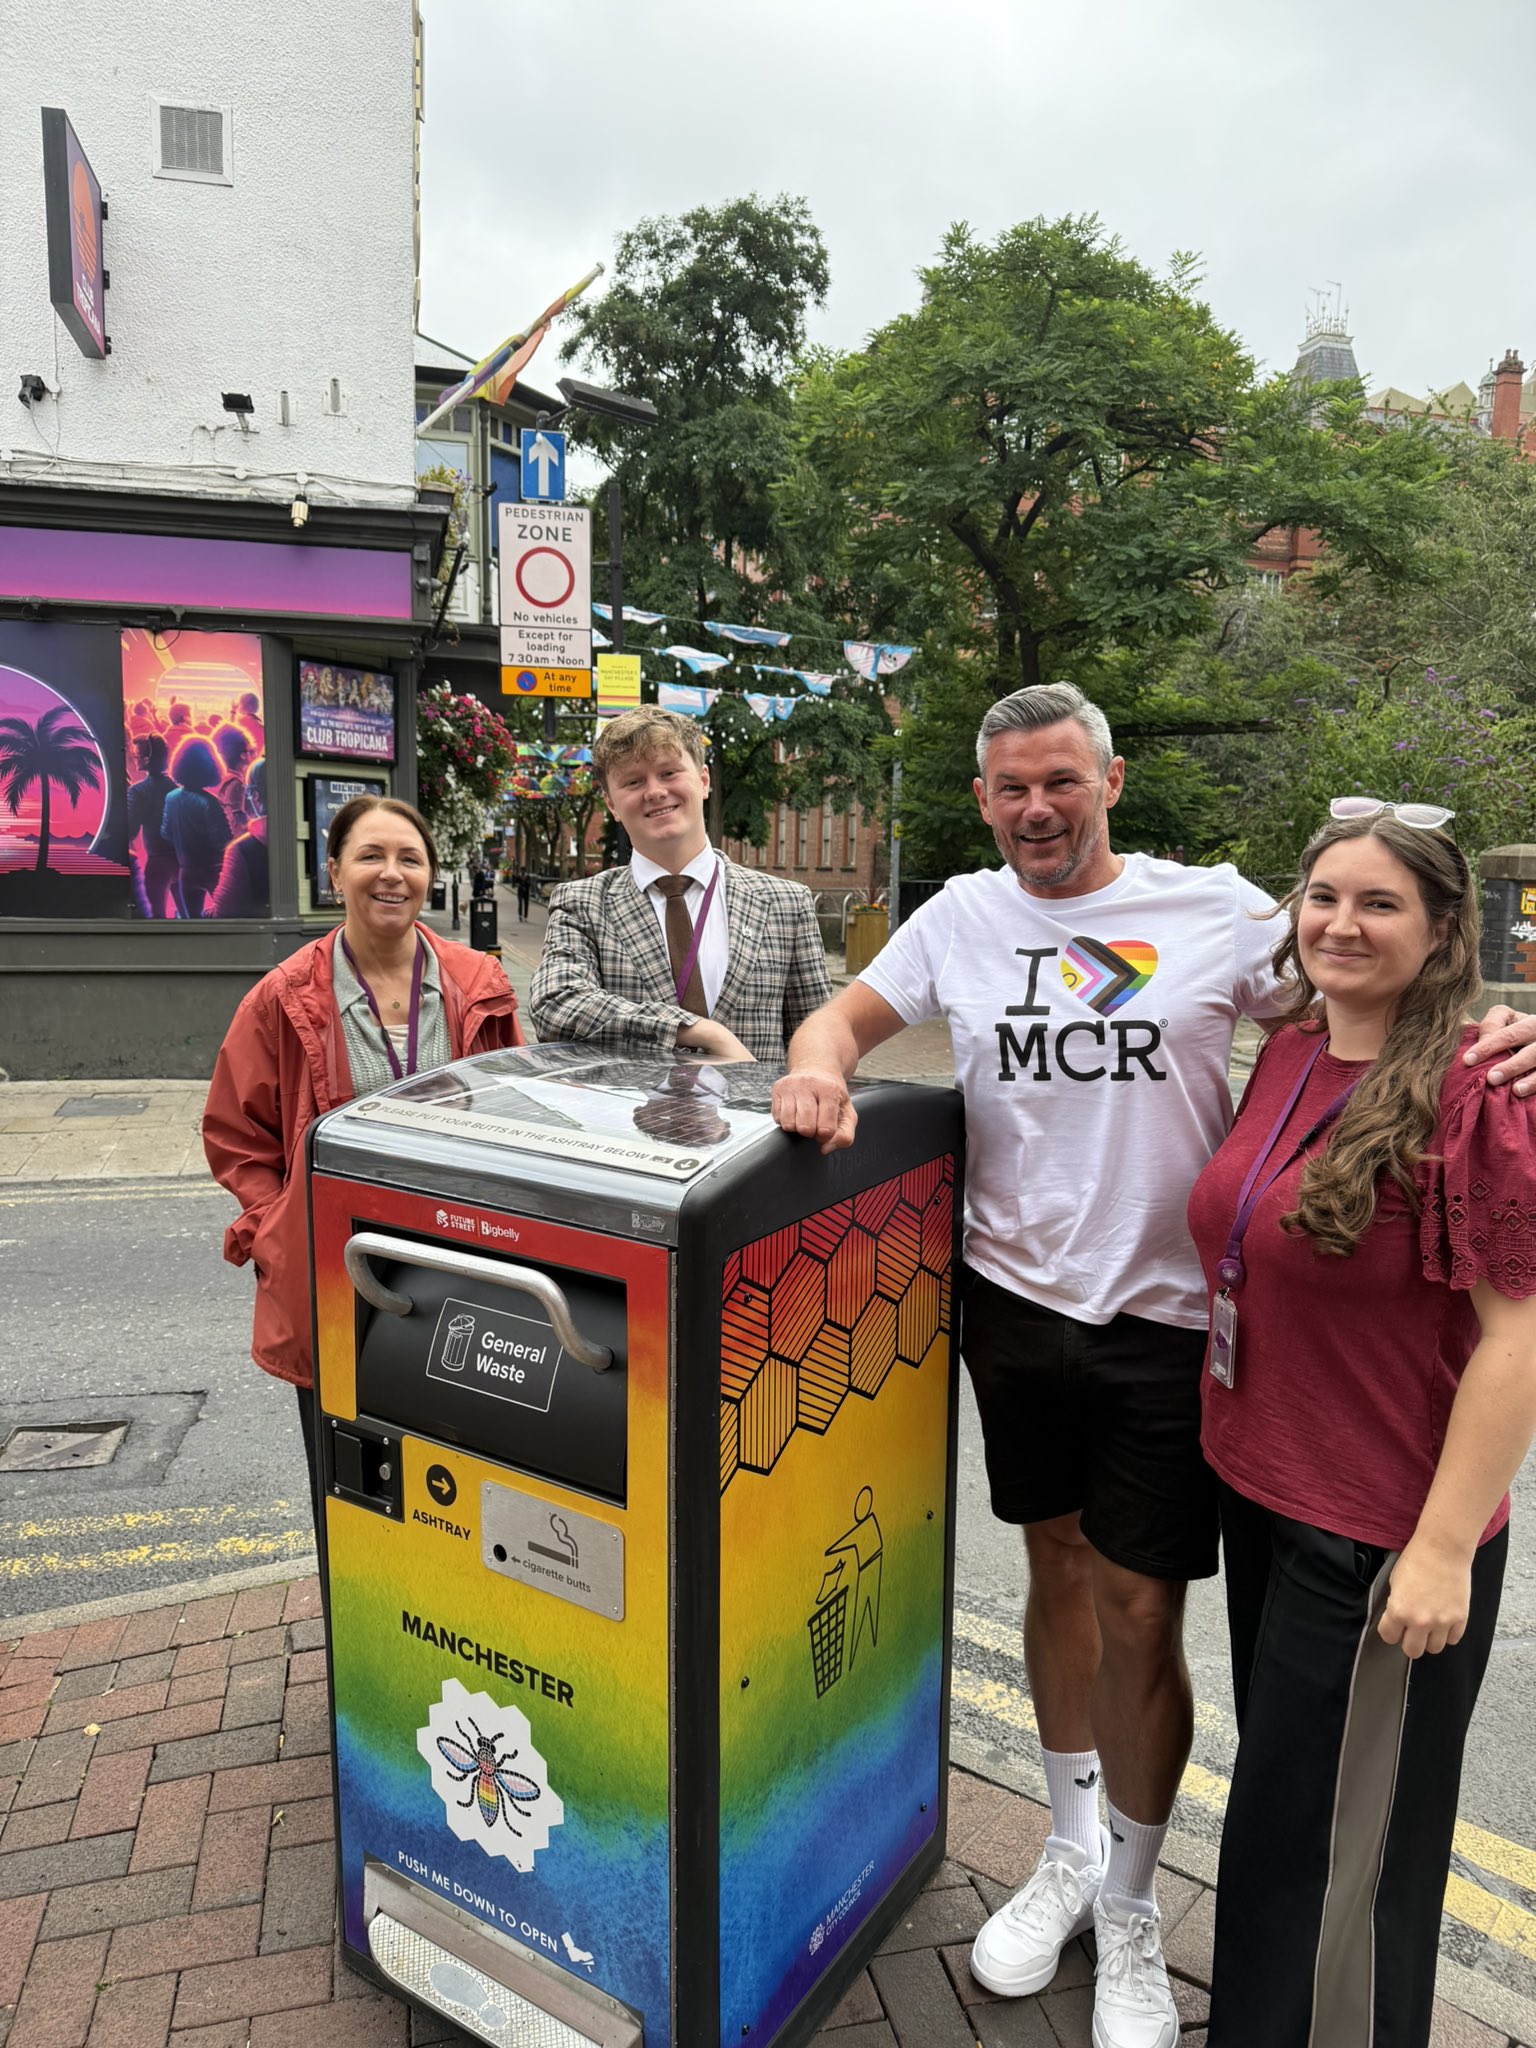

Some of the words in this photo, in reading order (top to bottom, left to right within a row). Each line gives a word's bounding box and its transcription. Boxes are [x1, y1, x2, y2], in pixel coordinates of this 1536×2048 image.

[505, 507, 584, 522] PEDESTRIAN
[517, 524, 572, 542] ZONE
[513, 611, 529, 622] No
[533, 613, 578, 624] vehicles
[518, 629, 555, 640] Except
[558, 632, 573, 641] for
[527, 641, 565, 653] loading
[544, 672, 555, 681] At
[559, 673, 577, 683] any
[549, 684, 571, 693] time
[306, 726, 333, 745] CLUB
[334, 729, 389, 752] TROPICANA
[1005, 947, 1058, 1016] I
[377, 1105, 418, 1118] PLEASE
[415, 1113, 441, 1121] PUT
[440, 1117, 472, 1127] YOUR
[470, 1121, 511, 1134] BUTTS
[507, 1129, 524, 1137] IN
[524, 1131, 548, 1141] THE
[548, 1136, 605, 1152] ASHTRAY
[602, 1146, 651, 1160] BELOW
[450, 1214, 475, 1226] FUTURE
[450, 1221, 476, 1233] STREET
[481, 1220, 520, 1242] Bigbelly
[481, 1331, 547, 1364] General
[476, 1353, 526, 1384] Waste
[412, 1509, 472, 1541] ASHTRAY
[523, 1559, 565, 1583] cigarette
[566, 1575, 592, 1593] butts
[402, 1610, 574, 1708] MANCHESTER
[398, 1851, 428, 1878] PUSH
[431, 1870, 450, 1891] ME
[453, 1883, 495, 1917] DOWN
[499, 1908, 517, 1928] TO
[520, 1922, 558, 1953] OPEN
[826, 1860, 875, 1926] MANCHESTER
